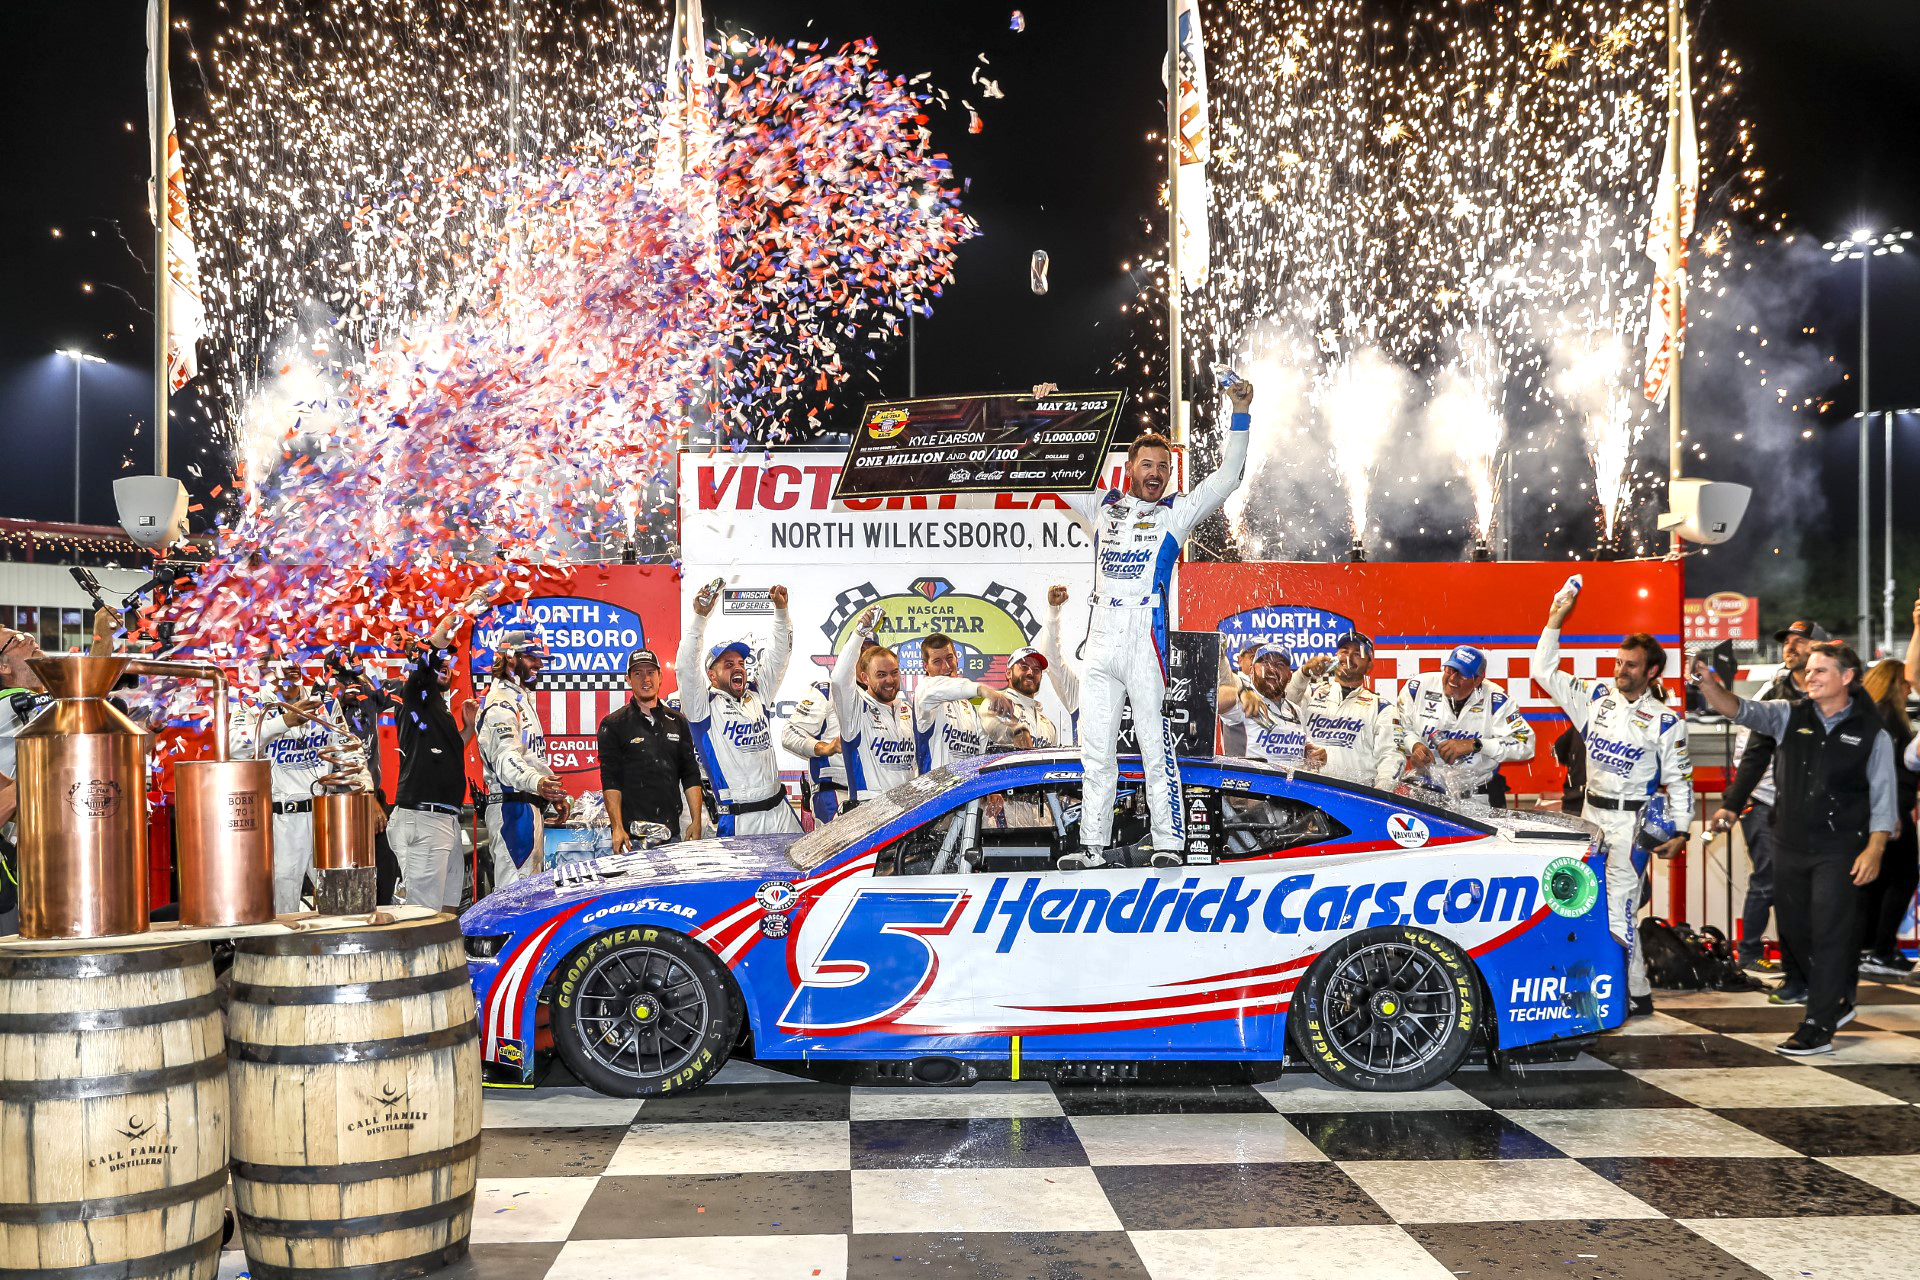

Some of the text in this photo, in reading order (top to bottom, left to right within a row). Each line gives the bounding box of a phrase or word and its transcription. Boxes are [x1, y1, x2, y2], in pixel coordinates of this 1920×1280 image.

[1036, 401, 1108, 412] MAY 21, 2023
[908, 432, 986, 446] KYLE LARSON
[1044, 432, 1096, 442] 1,000,000
[855, 448, 1019, 467] ONE MILLION AND 00/100
[1051, 469, 1086, 480] xfinity
[771, 522, 1090, 551] NORTH WILKESBORO, N.C.
[1099, 548, 1152, 564] Hendrick
[1102, 562, 1145, 573] Cars.com
[741, 591, 769, 599] NASCAR
[907, 606, 954, 614] NASCAR
[1252, 613, 1321, 628] NORTH
[478, 630, 638, 648] WESBORO
[969, 659, 984, 669] 23
[1307, 713, 1365, 732] Hendrick
[1256, 730, 1306, 748] Hendric
[1312, 728, 1357, 742] Cars.com
[1422, 724, 1482, 743] Hdrick
[550, 741, 599, 750] CAROLI
[870, 737, 915, 756] Hendric
[1587, 731, 1645, 761] Hendrick
[277, 750, 319, 764] Cars.co
[1591, 749, 1634, 771] Cars.com
[228, 796, 254, 806] BORN
[228, 819, 256, 828] SHINE
[582, 898, 698, 924] GOODYEAR
[775, 888, 970, 1031] 5
[558, 929, 659, 1009] GOODYEAR
[1510, 974, 1612, 1003] HIRIG
[1509, 1004, 1610, 1022] TECHNICS
[1308, 1019, 1347, 1072] EAGLE
[661, 1047, 713, 1092] EAGLE
[347, 1111, 428, 1132] CALL FAMILY
[366, 1122, 414, 1136] DISTILLERS
[88, 1146, 178, 1168] CALL FAMILY
[109, 1158, 162, 1172] DISTILLERS
